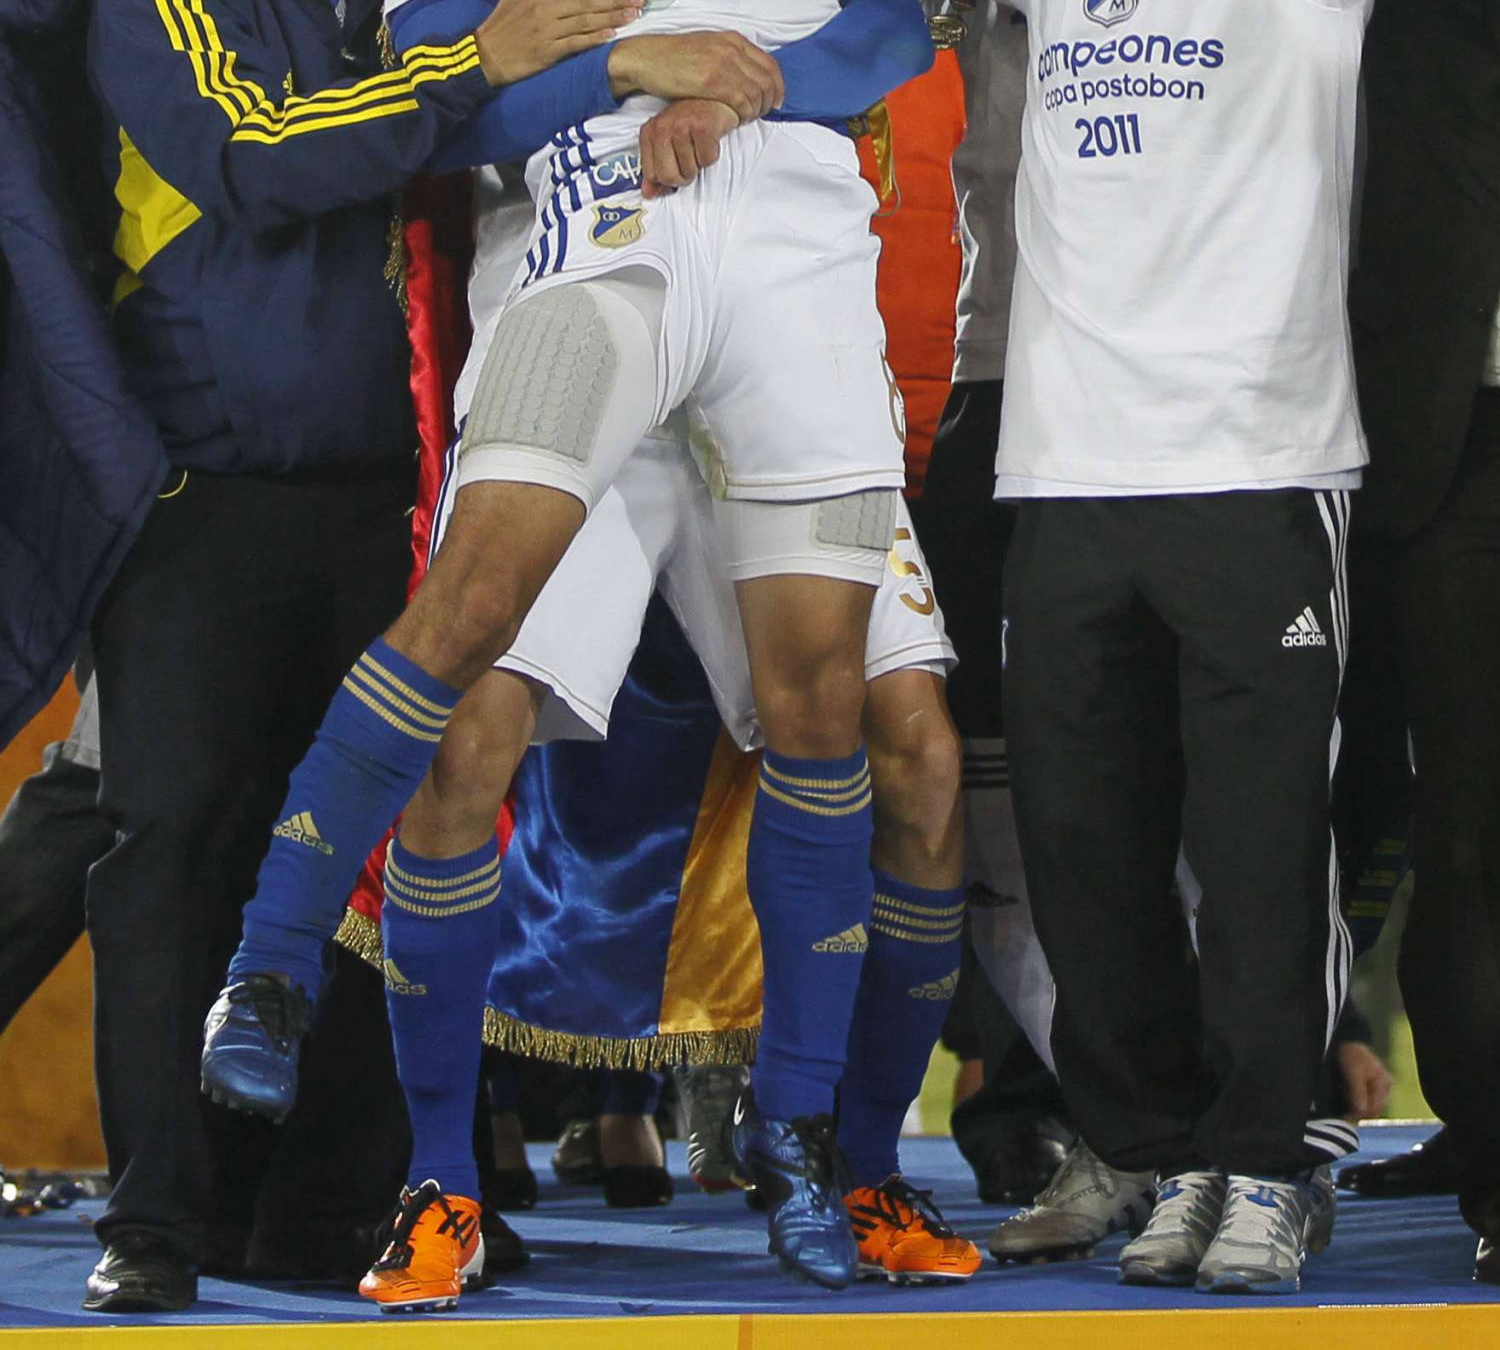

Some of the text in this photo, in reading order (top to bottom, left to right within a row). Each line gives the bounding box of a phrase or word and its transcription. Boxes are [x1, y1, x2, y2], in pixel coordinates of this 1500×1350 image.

[1038, 34, 1225, 82] campeones
[1045, 72, 1205, 114] copa postobon
[1074, 113, 1143, 159] 2011
[1281, 631, 1327, 648] adidas
